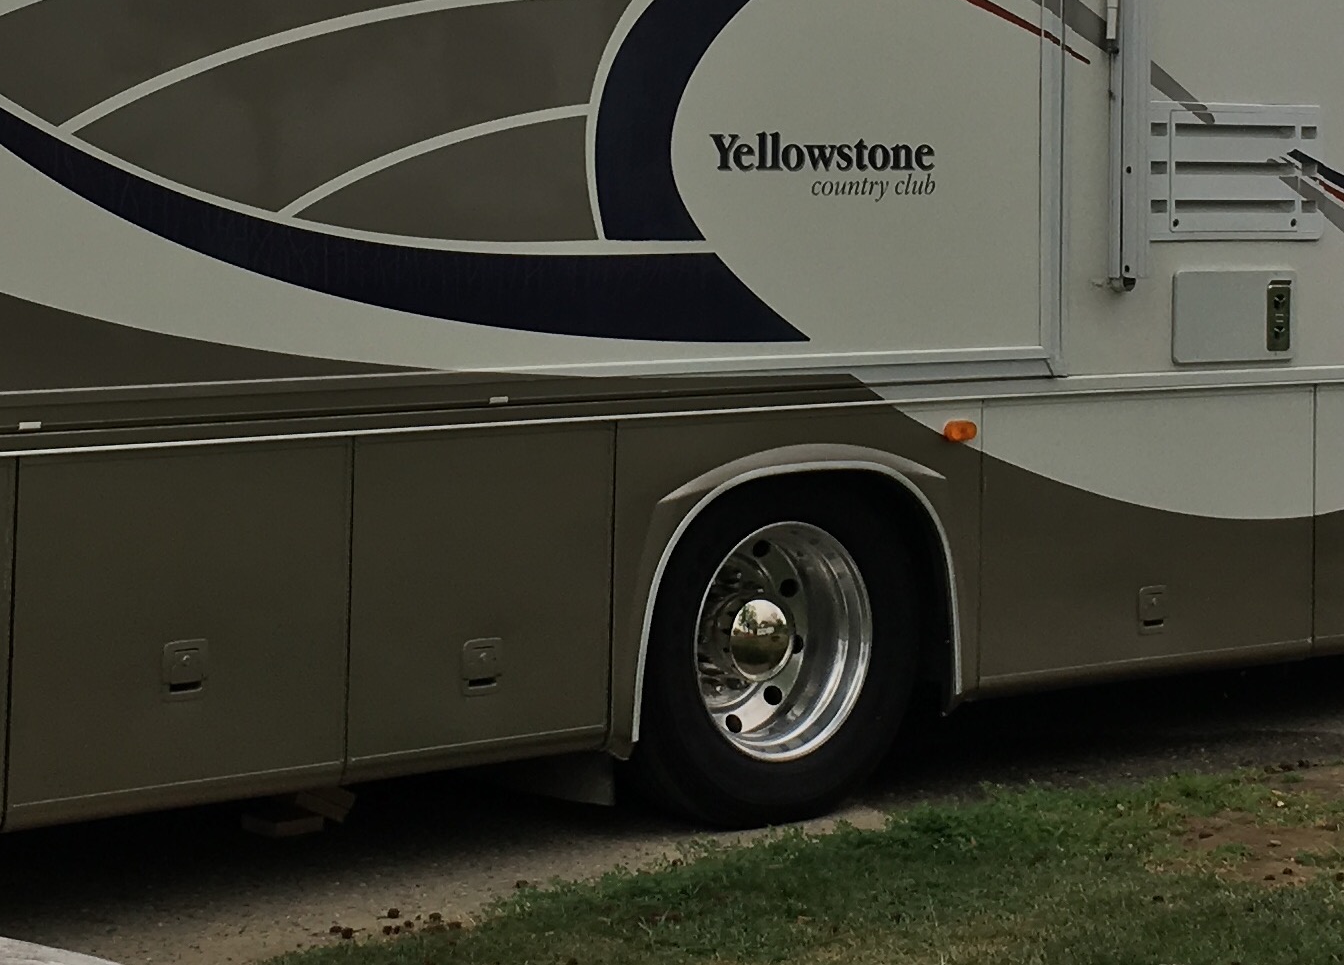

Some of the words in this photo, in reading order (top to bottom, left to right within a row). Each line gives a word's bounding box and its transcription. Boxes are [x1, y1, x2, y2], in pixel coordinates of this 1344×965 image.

[709, 131, 936, 172] Yellowstone
[811, 177, 889, 203] country
[894, 173, 936, 196] club
